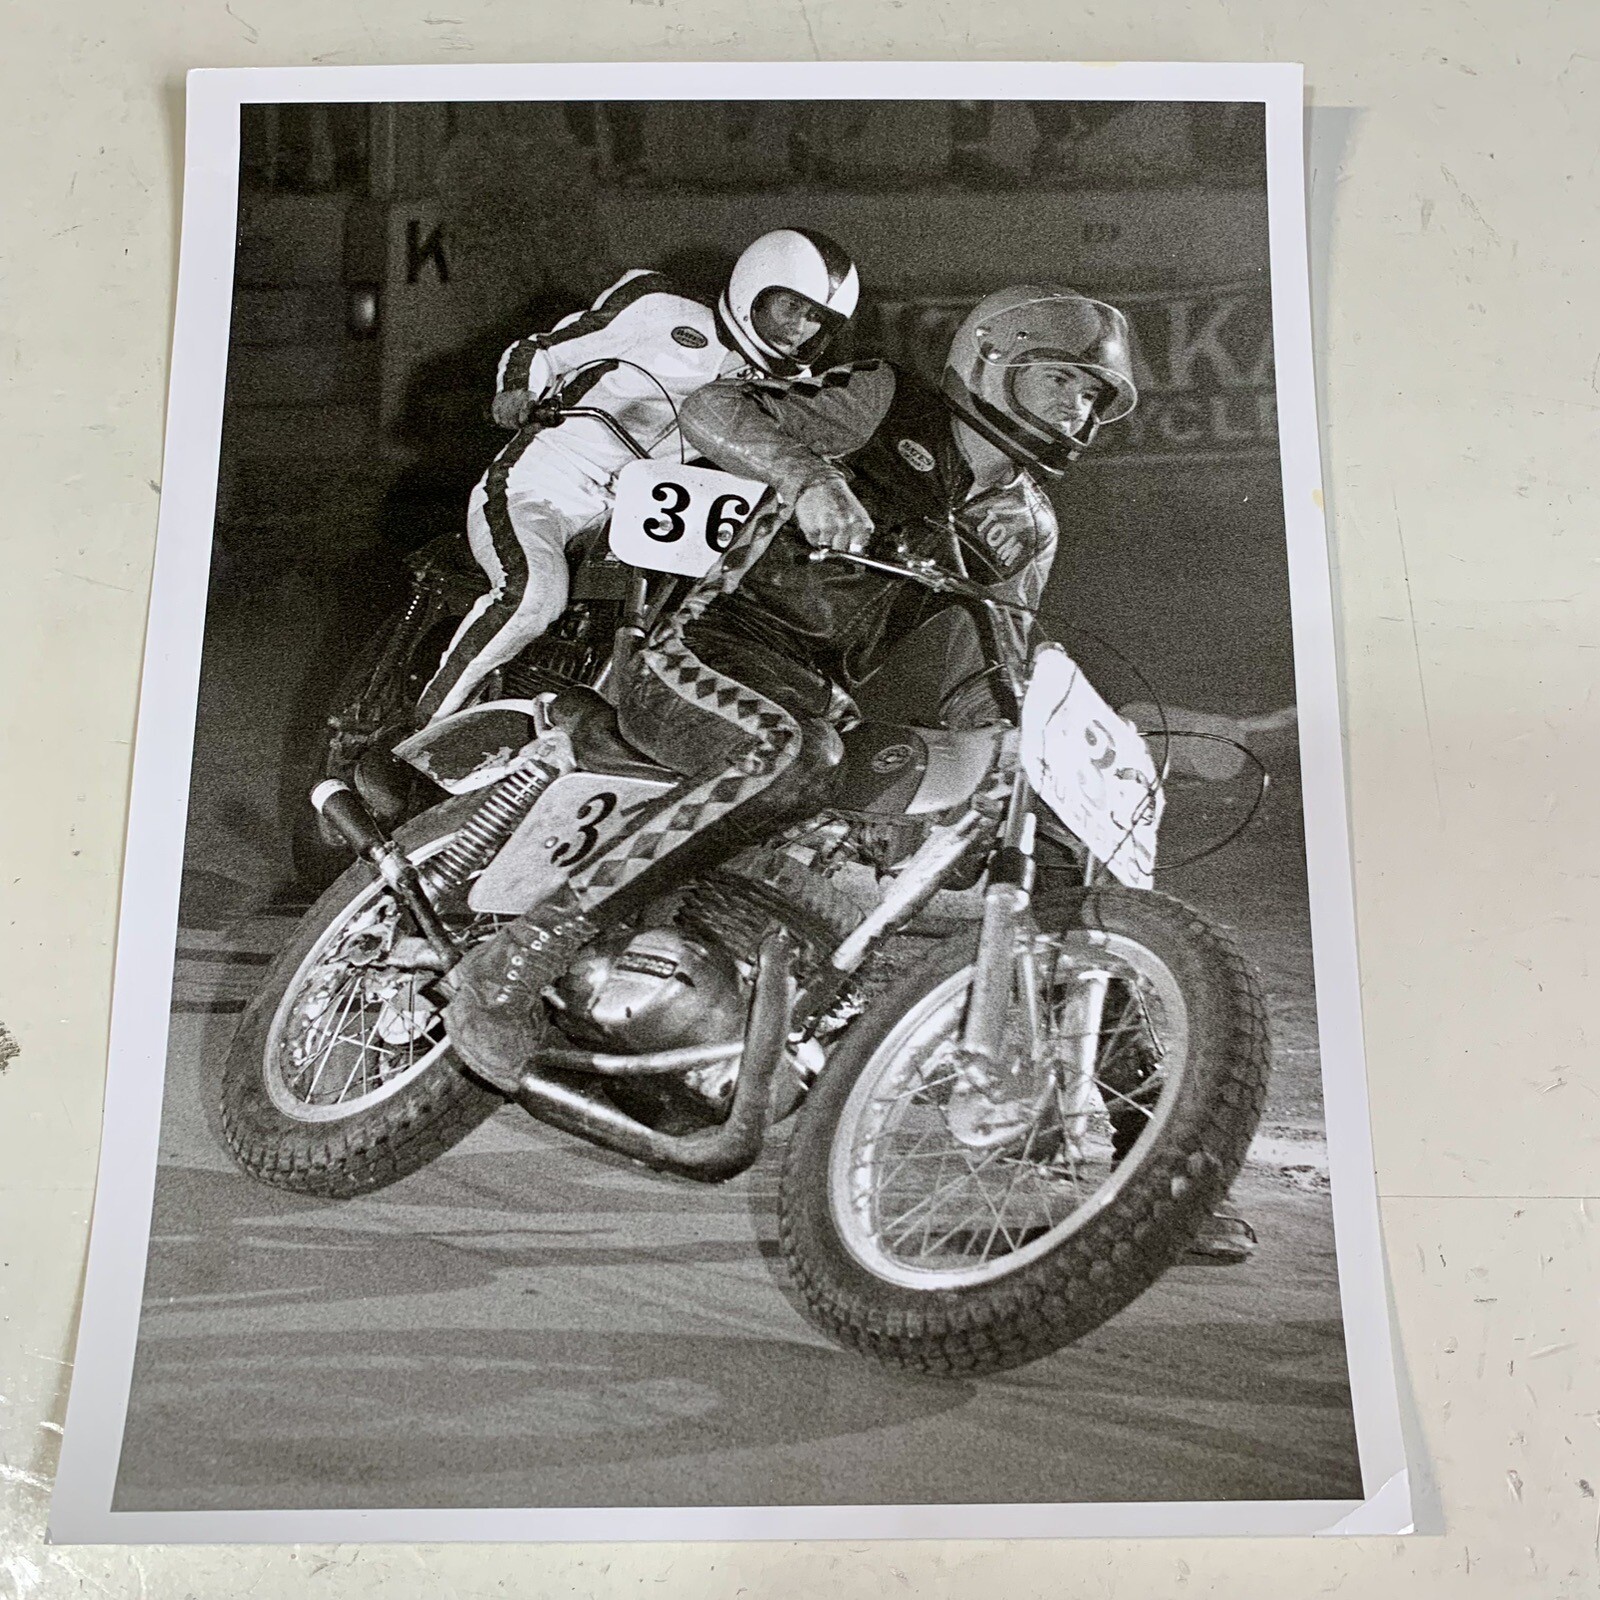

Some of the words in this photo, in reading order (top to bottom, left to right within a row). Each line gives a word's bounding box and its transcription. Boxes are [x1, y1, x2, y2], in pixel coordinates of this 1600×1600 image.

[643, 481, 751, 554] 36
[976, 508, 1024, 567] TOM
[549, 791, 650, 868] 3
